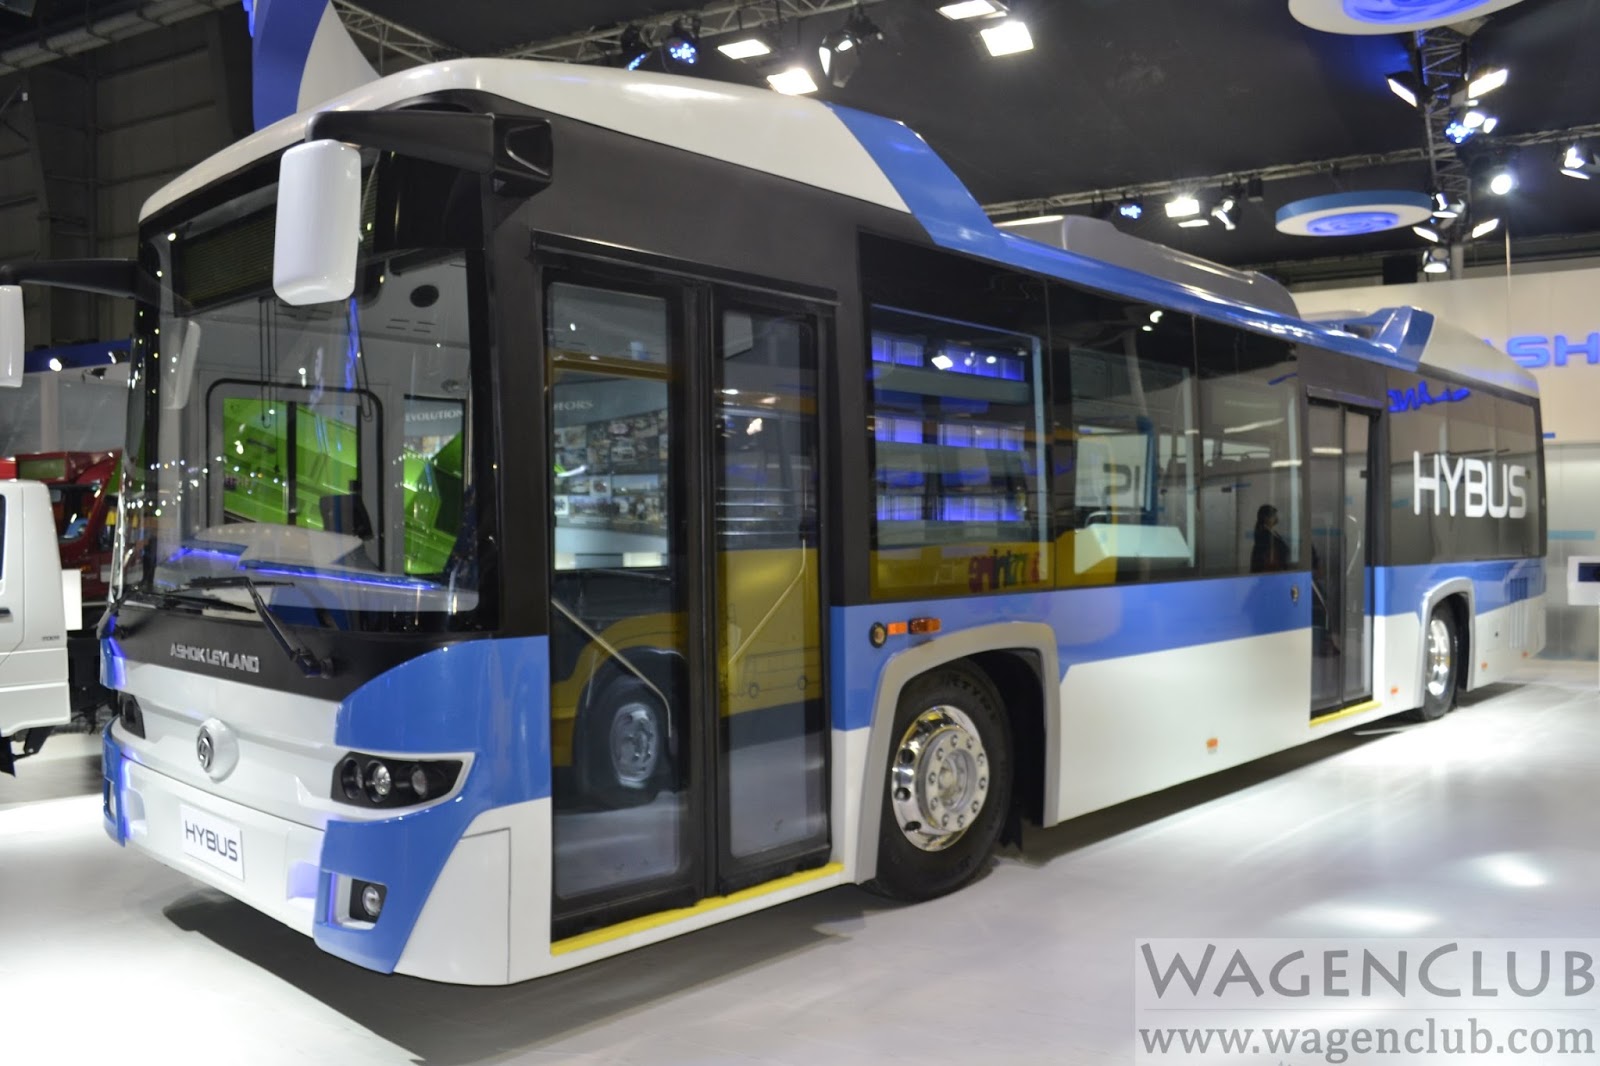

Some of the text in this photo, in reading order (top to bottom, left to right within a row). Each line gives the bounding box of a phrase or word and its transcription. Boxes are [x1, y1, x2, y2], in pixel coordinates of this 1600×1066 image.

[1483, 332, 1600, 369] SH
[1413, 450, 1527, 519] HYBUS
[170, 642, 260, 674] ASHOK LEYLAND
[184, 819, 238, 862] HYBUS
